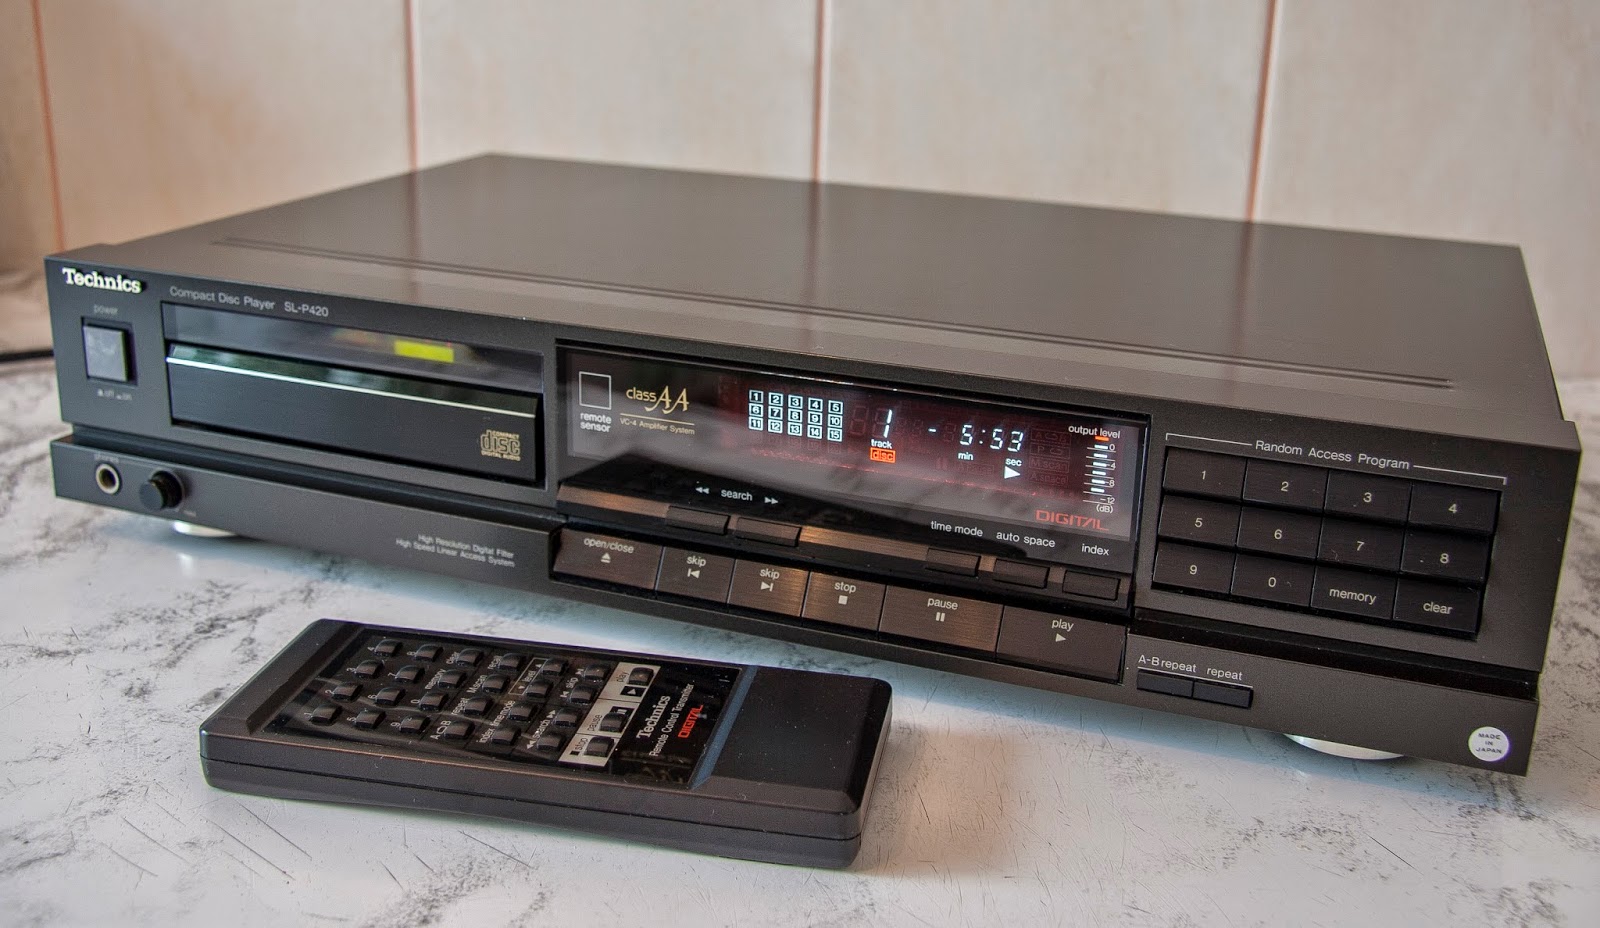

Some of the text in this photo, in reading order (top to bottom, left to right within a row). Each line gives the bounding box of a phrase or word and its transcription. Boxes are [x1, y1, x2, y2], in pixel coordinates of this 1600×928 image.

[62, 267, 141, 294] Technics
[169, 285, 329, 318] Compact Disc Player SL-P420
[93, 304, 118, 315] power
[626, 386, 657, 402] class
[580, 412, 612, 425] remote
[883, 408, 893, 439] 1
[580, 421, 611, 433] sensor
[620, 418, 695, 435] VC-4 Amplifier System
[1068, 425, 1098, 436] output
[1100, 428, 1121, 439] level
[480, 429, 521, 456] disc
[871, 438, 893, 449] track
[871, 449, 895, 462] disc
[958, 451, 974, 461] min
[1255, 440, 1410, 470] Random Access Program
[1005, 458, 1022, 467] sec
[1201, 470, 1207, 480] 1
[1280, 481, 1289, 492] 2
[721, 488, 753, 502] search
[1363, 492, 1372, 503] 3
[1096, 503, 1114, 514] (dB)
[1448, 503, 1458, 514] 4
[1035, 509, 1109, 531] DIGITAL
[1194, 518, 1203, 528] 5
[930, 519, 983, 538] time mode
[1274, 529, 1283, 540] 6
[418, 534, 434, 545] High
[472, 544, 494, 555] Digital
[496, 548, 514, 559] Filter
[583, 536, 634, 554] open/close
[996, 530, 1056, 549] auto space
[1356, 541, 1365, 551] 7
[395, 538, 516, 568] High Speed Linear Access System
[1081, 542, 1110, 557] index
[686, 555, 707, 567] skip
[1440, 553, 1449, 564] 8
[759, 567, 780, 581] skip
[1189, 564, 1198, 575] 9
[834, 580, 857, 594] stop
[1268, 577, 1277, 588] 0
[1329, 587, 1377, 606] memory
[927, 597, 958, 612] pause
[1423, 601, 1453, 615] clear
[1051, 618, 1074, 632] play
[1138, 654, 1197, 673] A-B repeat
[616, 671, 630, 683] play
[1206, 667, 1243, 681] repeat
[587, 714, 603, 732] pause
[636, 695, 671, 739] Technics
[648, 683, 695, 757] Remote Control Transmitter
[677, 704, 704, 738] DIGITAL
[574, 737, 589, 751] stop
